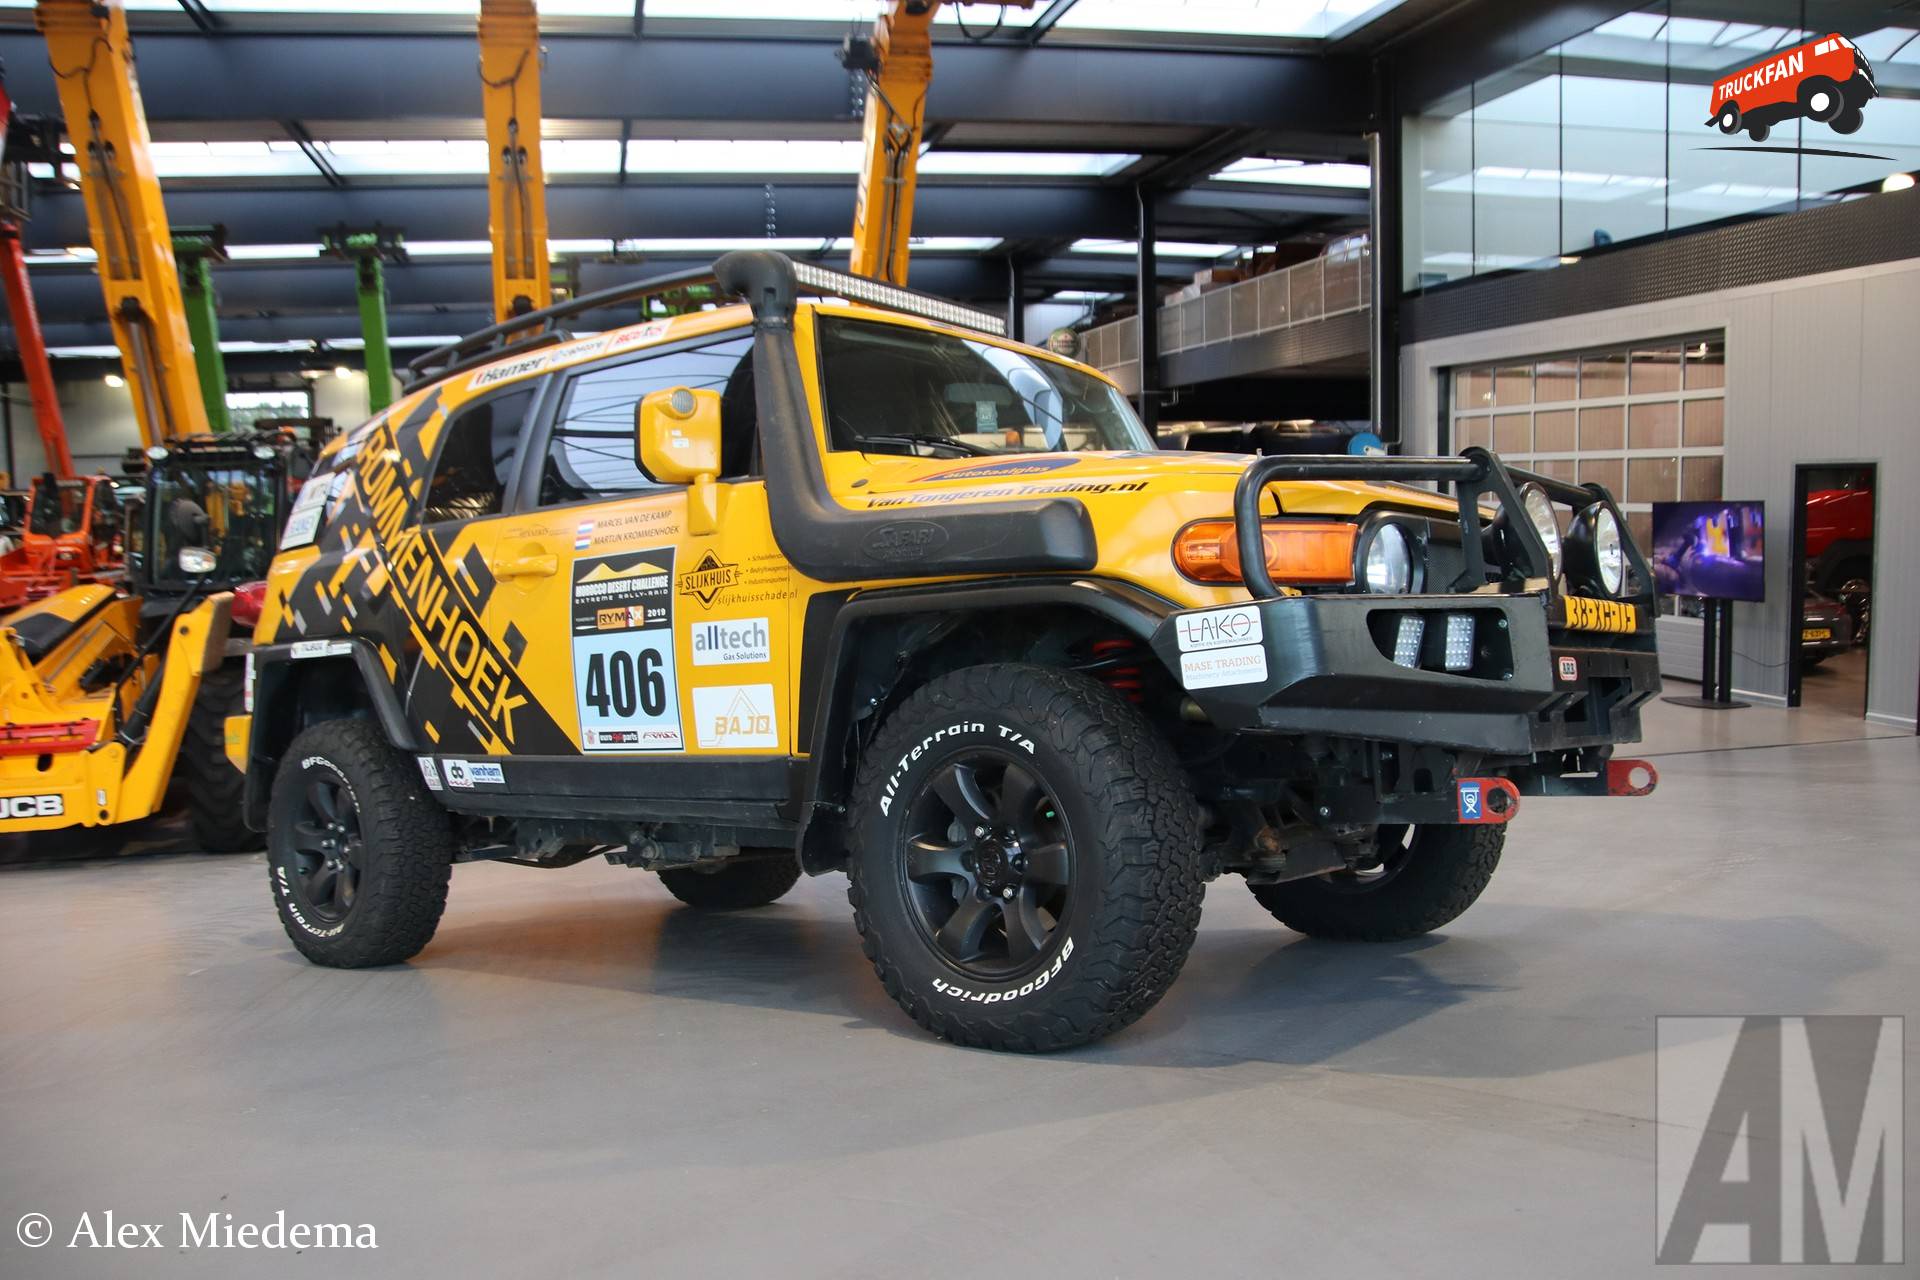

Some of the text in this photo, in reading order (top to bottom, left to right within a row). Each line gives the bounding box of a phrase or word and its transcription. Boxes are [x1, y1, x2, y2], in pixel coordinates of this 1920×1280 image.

[941, 465, 1052, 480] autotaalglas
[597, 518, 623, 529] MARCEL
[624, 514, 640, 525] VAN
[650, 509, 673, 521] KAMP
[623, 526, 681, 541] KROMMENHOEK
[872, 527, 935, 548] SAFARI
[575, 575, 669, 598] MOROCCO DESERT CHALLENGE
[685, 569, 732, 591] SLIJKHUIS
[575, 595, 614, 605] EXTREME
[599, 609, 643, 624] RYMAX
[647, 608, 667, 618] 2019
[695, 622, 768, 652] alltech
[1187, 613, 1251, 643] LAKO
[723, 650, 767, 661] Gas Solutions
[1184, 655, 1261, 673] MASE TRADING
[585, 648, 667, 718] 406
[880, 720, 1036, 817] All-Terrain T/A
[932, 936, 1075, 1005] BFGoodrich
